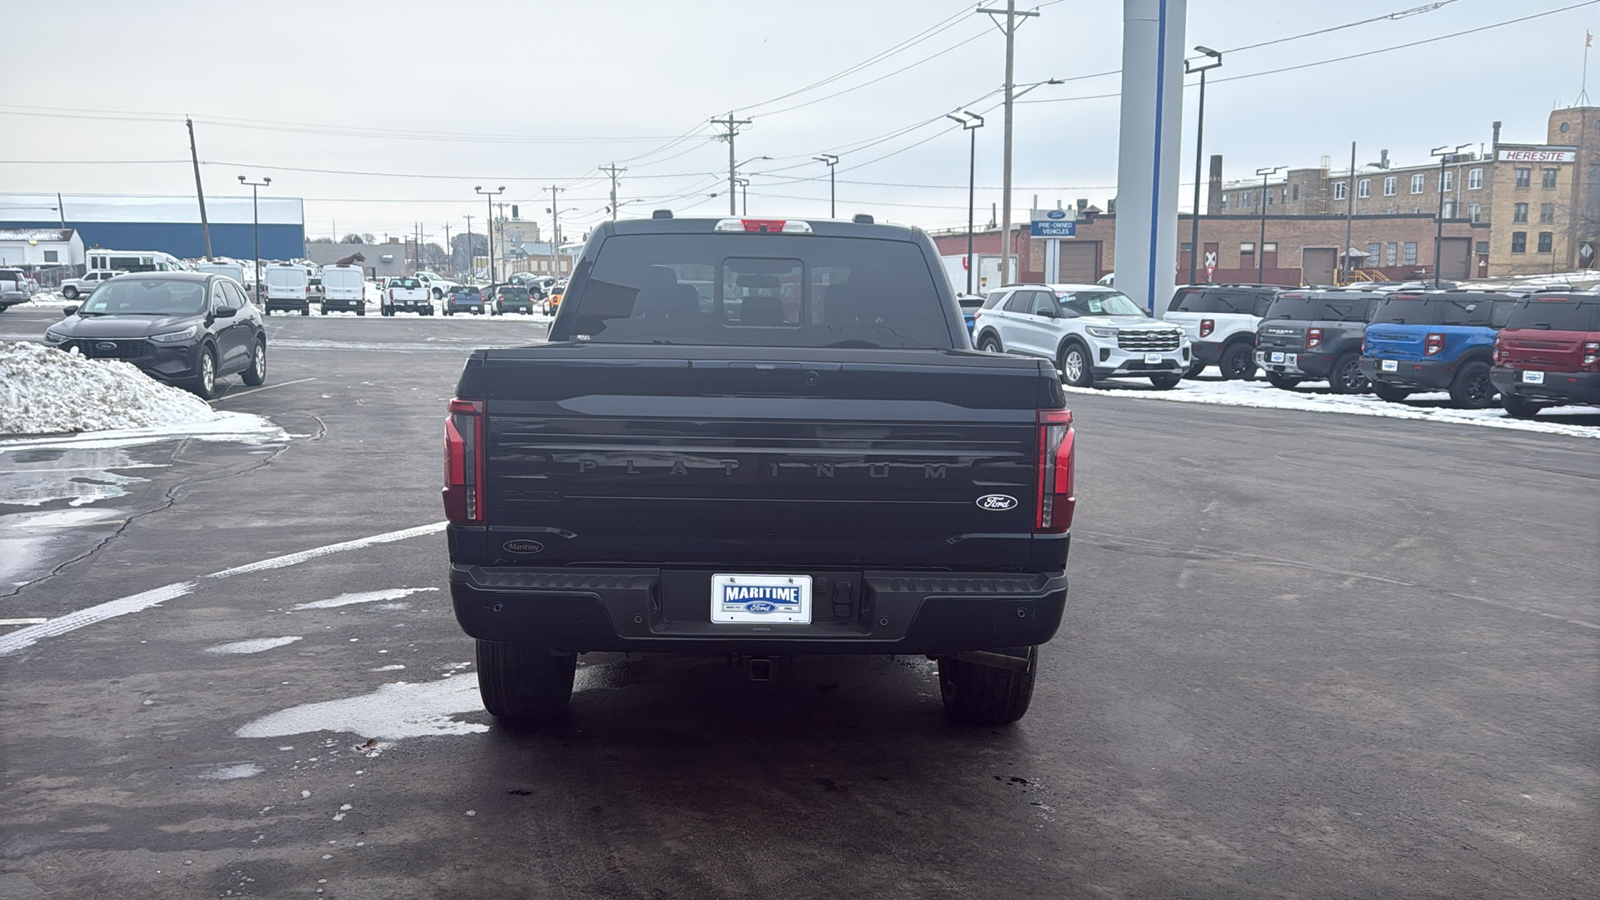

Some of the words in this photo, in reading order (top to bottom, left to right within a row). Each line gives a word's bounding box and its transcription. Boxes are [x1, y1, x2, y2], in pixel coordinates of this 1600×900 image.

[1506, 151, 1565, 161] HERESITE
[578, 459, 947, 479] PLATINUM
[983, 496, 1011, 508] Ford
[725, 586, 799, 603] MARITIME
[750, 603, 772, 612] Ford
